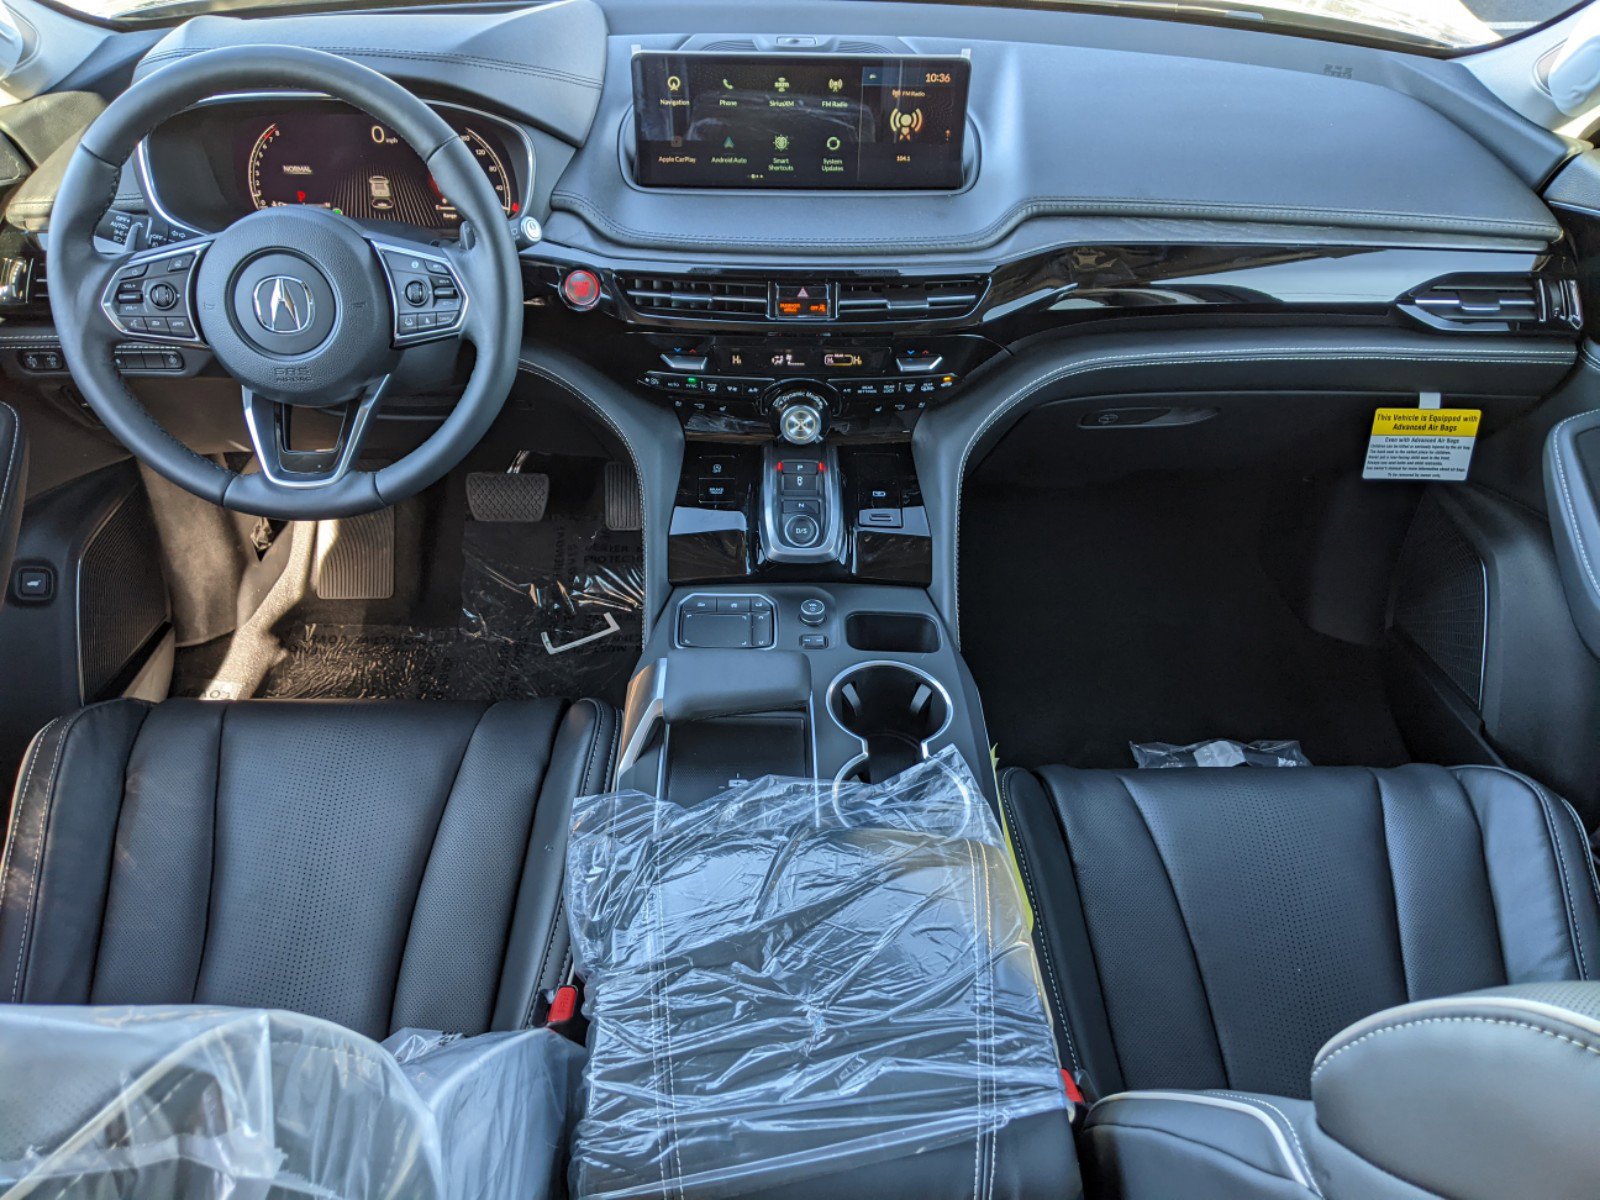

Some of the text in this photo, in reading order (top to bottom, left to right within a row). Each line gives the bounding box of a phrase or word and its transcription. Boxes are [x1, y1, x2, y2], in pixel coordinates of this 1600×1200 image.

[925, 73, 951, 83] 10:36
[659, 99, 690, 108] Navigation
[719, 99, 738, 107] Phone
[371, 125, 385, 143] 0
[658, 156, 697, 164] Apple CarPlay
[711, 156, 748, 164] Android Auto
[282, 165, 312, 174] NORMAL
[1377, 413, 1478, 423] This Vehicle is Equipped with
[1392, 423, 1427, 431] Advanced
[1440, 424, 1457, 432] Bags
